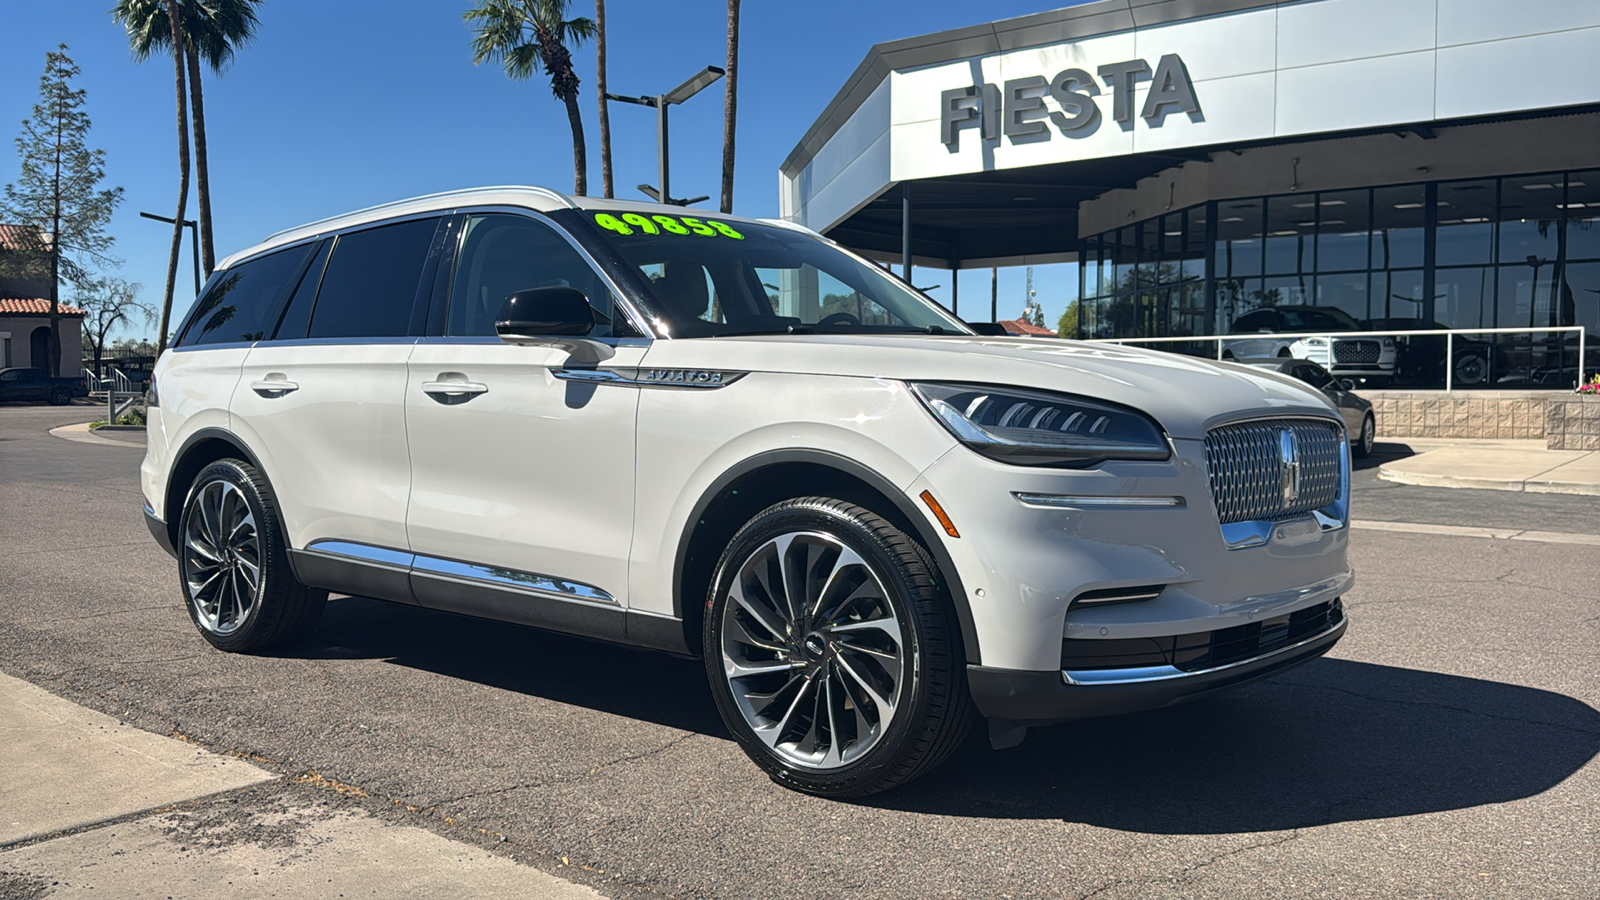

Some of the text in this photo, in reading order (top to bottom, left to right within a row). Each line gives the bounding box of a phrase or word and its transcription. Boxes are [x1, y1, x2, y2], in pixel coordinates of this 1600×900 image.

[941, 53, 1201, 145] FIESTA
[594, 213, 745, 240] 49858
[647, 370, 723, 382] AVIATOR
